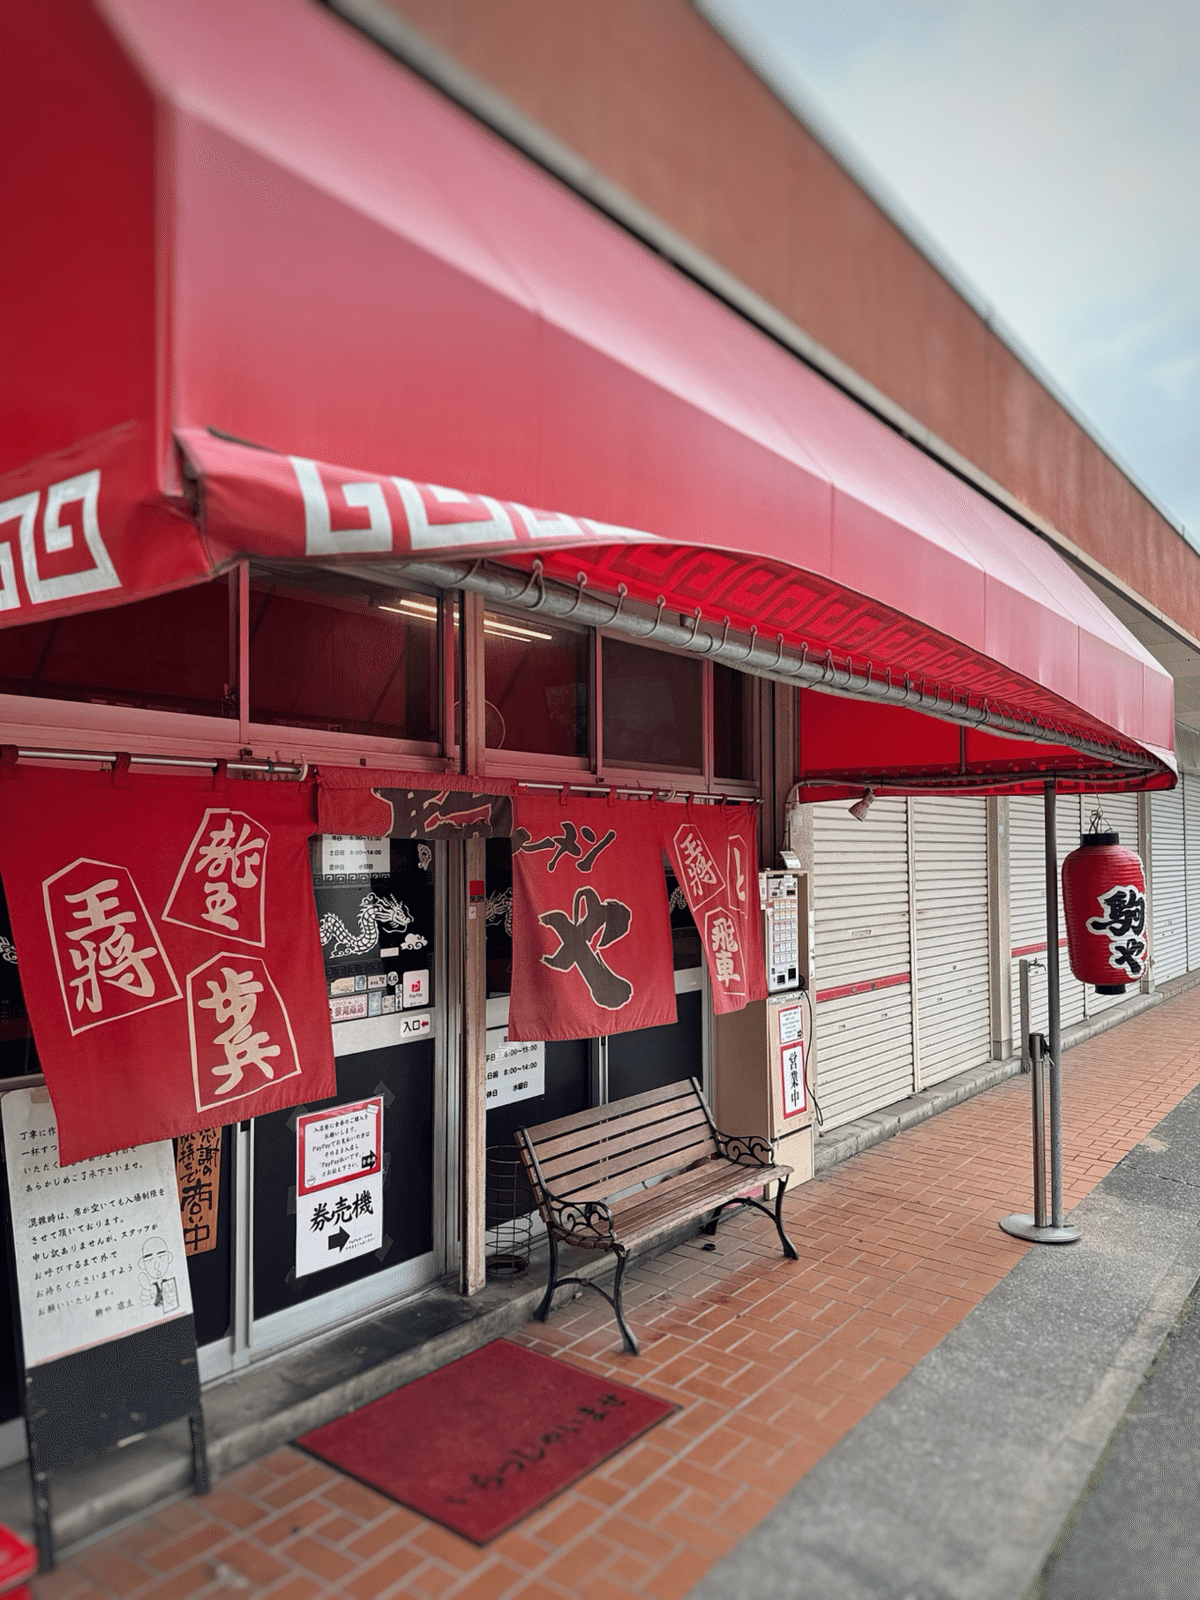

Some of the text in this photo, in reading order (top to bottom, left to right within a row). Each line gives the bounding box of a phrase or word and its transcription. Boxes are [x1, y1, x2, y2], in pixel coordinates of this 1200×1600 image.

[711, 917, 741, 988] 飛車
[1089, 888, 1146, 977] 駒や
[402, 1019, 421, 1034] 入口
[309, 1189, 374, 1233] 券売機
